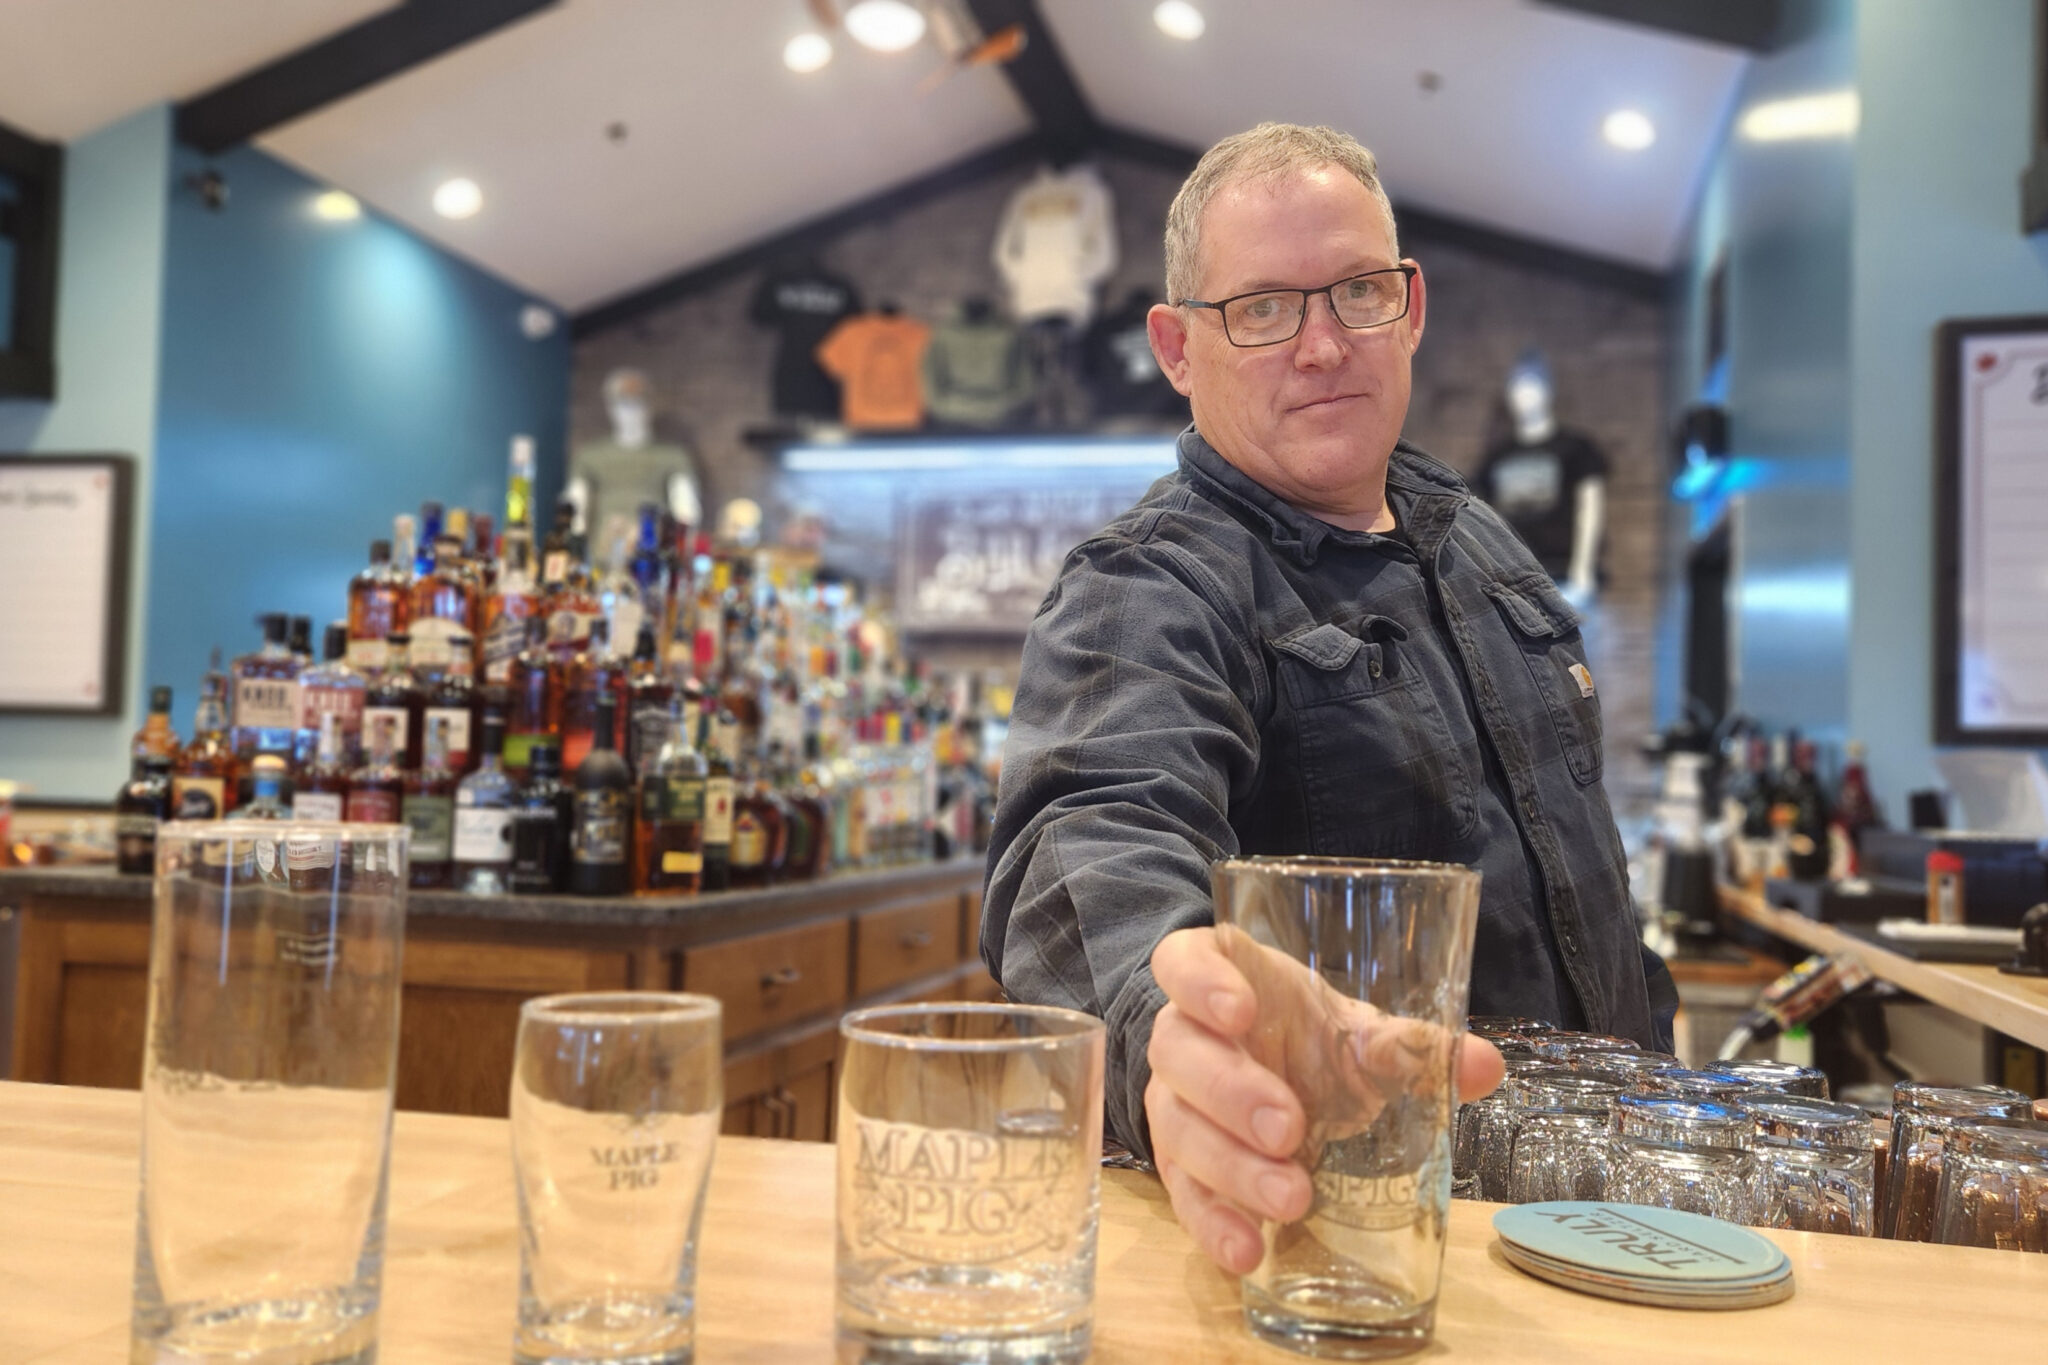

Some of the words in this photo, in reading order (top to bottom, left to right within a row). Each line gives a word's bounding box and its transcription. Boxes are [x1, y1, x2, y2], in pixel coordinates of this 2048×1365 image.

[589, 1142, 681, 1167] MAPLE
[609, 1168, 660, 1191] PIG
[893, 1183, 1014, 1237] PIG
[1534, 1211, 1699, 1269] TRULY
